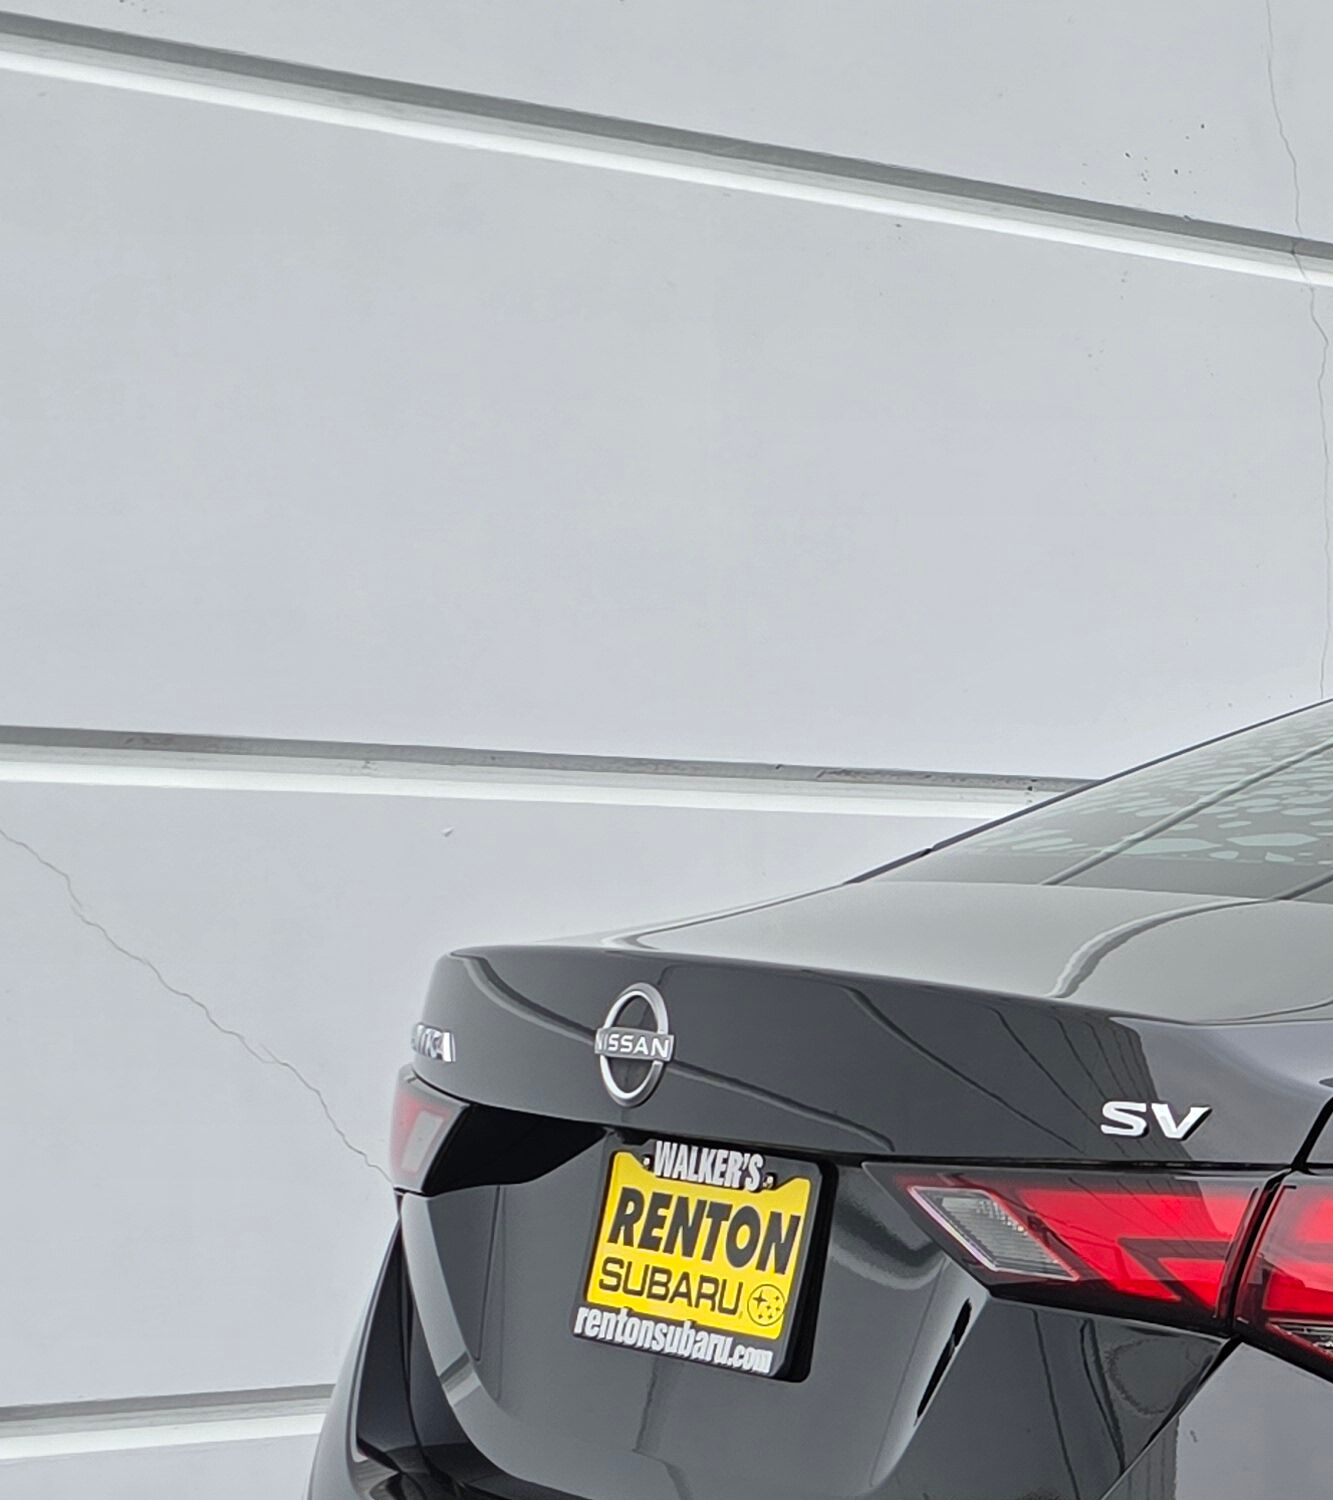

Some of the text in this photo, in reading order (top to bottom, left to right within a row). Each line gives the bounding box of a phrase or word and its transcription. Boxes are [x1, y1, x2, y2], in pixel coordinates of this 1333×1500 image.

[596, 1033, 671, 1058] NISSAN
[1100, 1101, 1211, 1140] SV
[654, 1140, 764, 1191] WALKER'S
[607, 1187, 801, 1275] RENTON
[599, 1257, 743, 1316] SUBARU
[573, 1306, 773, 1373] rentonsubaru.com
